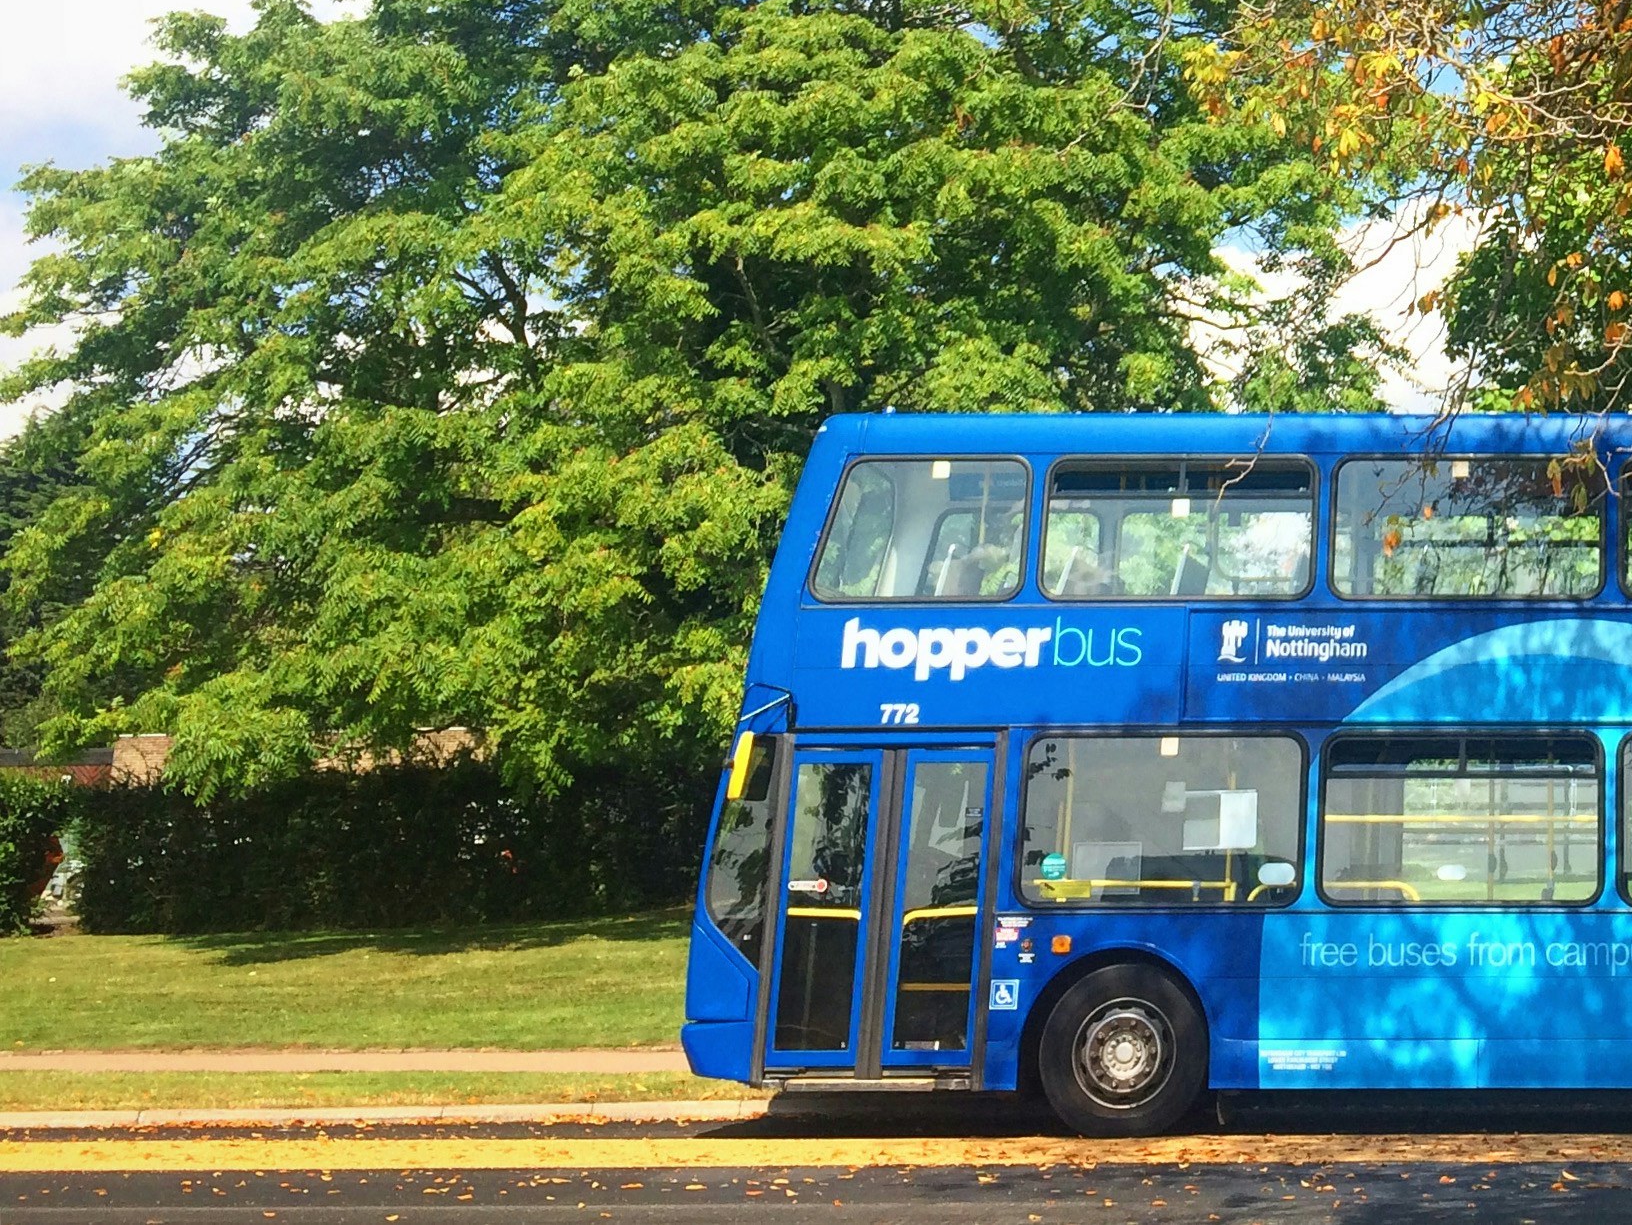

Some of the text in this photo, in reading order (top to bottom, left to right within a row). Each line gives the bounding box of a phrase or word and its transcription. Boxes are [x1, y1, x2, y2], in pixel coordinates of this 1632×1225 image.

[1266, 625, 1355, 639] The University of
[841, 616, 1142, 681] hopperbus
[1266, 638, 1367, 662] Nottingham
[1217, 673, 1366, 682] UNITED KINGDOM CHINA MALAYSIA
[880, 703, 920, 724] 772
[1300, 932, 1358, 966] free
[1368, 933, 1457, 966] buses
[1467, 932, 1536, 966] from
